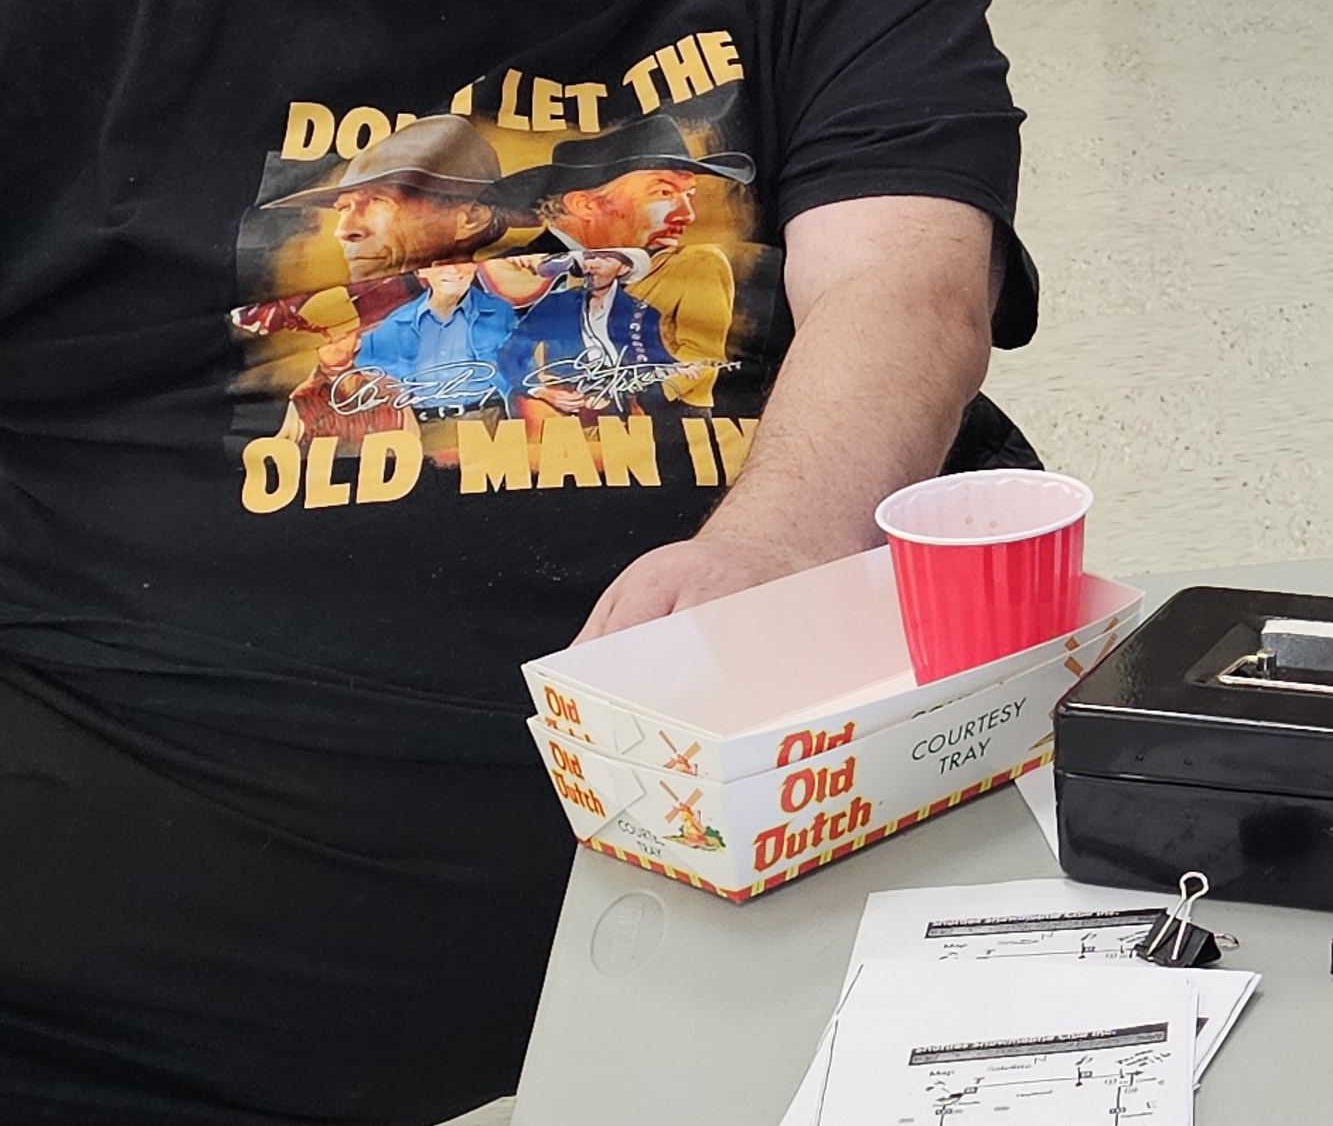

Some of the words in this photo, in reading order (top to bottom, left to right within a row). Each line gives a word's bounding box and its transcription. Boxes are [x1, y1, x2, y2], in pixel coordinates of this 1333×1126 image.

[498, 68, 607, 132] LET
[622, 30, 744, 113] THE
[241, 429, 423, 514] OLD
[457, 415, 661, 494] MAN
[544, 686, 580, 725] Old
[912, 698, 1026, 761] COURTESY
[549, 740, 584, 780] Old
[780, 756, 856, 813] Old
[939, 738, 991, 774] TRAY
[552, 770, 606, 817] Dutch
[754, 796, 872, 872] Dutch
